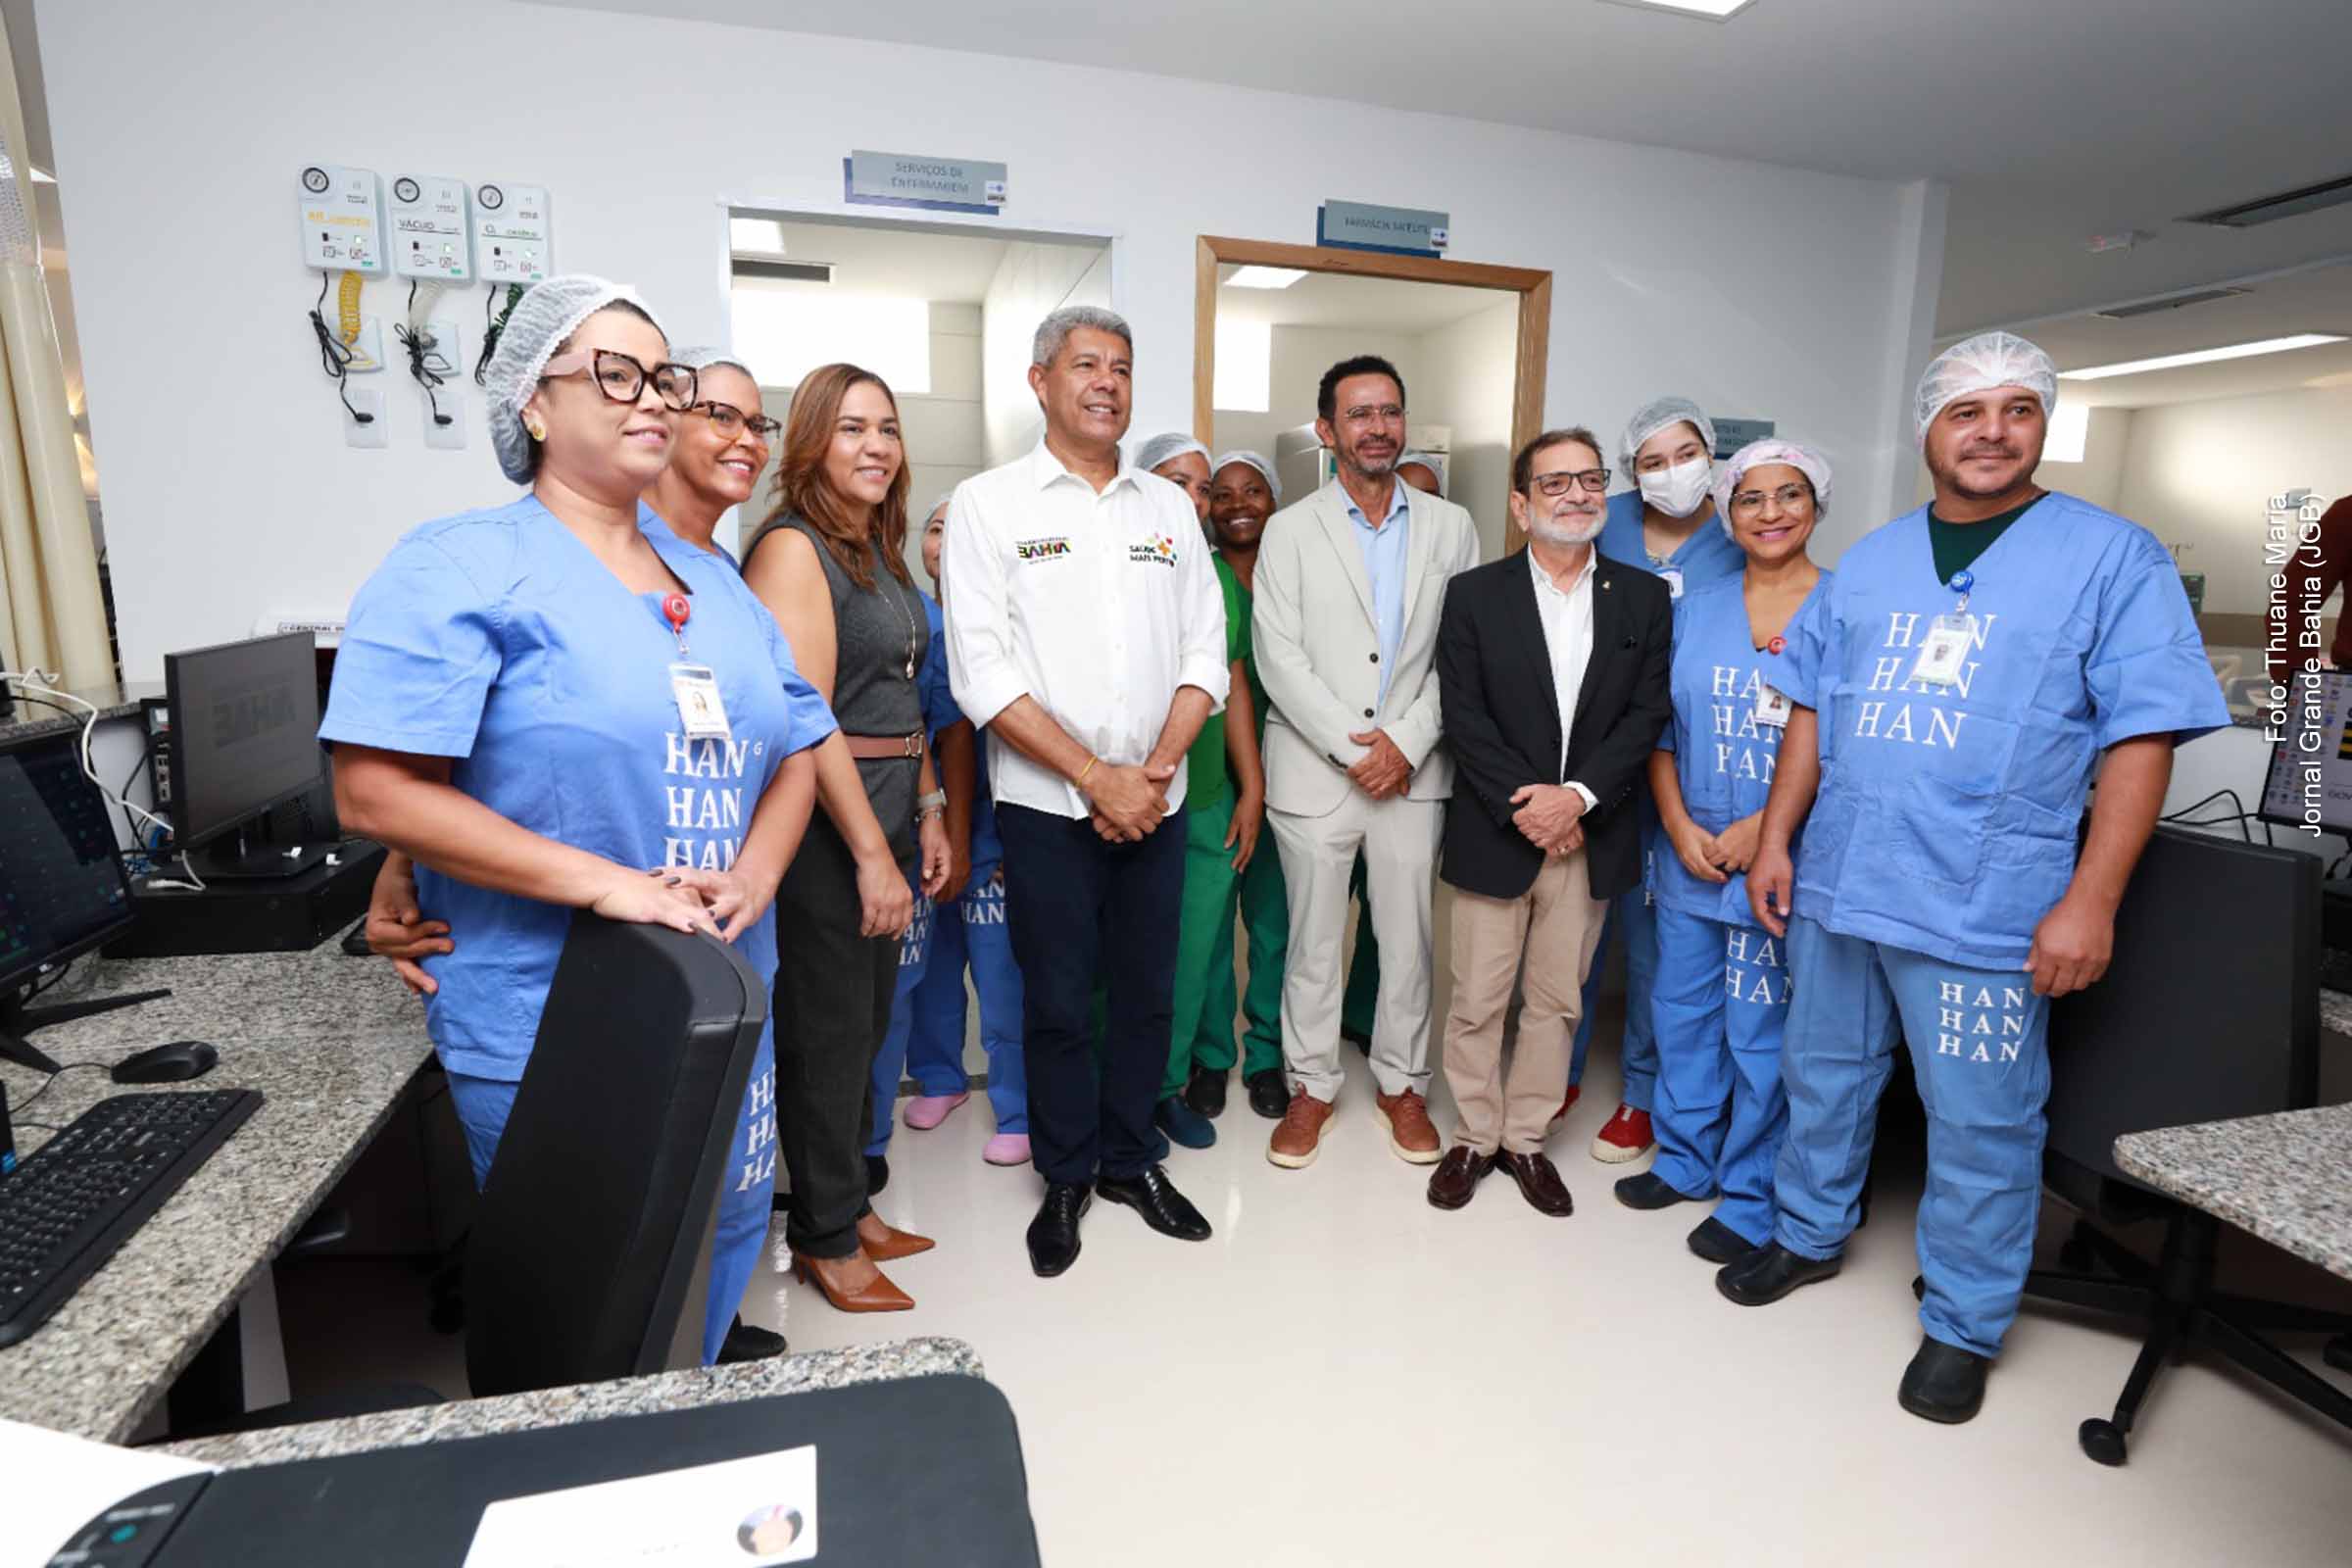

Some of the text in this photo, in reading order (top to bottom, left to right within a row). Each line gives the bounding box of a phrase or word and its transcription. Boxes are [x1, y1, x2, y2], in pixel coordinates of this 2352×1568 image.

[1017, 542, 1071, 559] BAHIA
[1883, 612, 1998, 651] HN
[1711, 665, 1769, 699] HA
[1854, 702, 1968, 749] HAN
[663, 732, 746, 779] HAN
[665, 786, 743, 830] HAN
[1727, 926, 1788, 966] HA
[1939, 980, 2025, 1008] HAN
[1939, 1006, 2024, 1036] HAN
[1936, 1033, 2022, 1062] HAN
